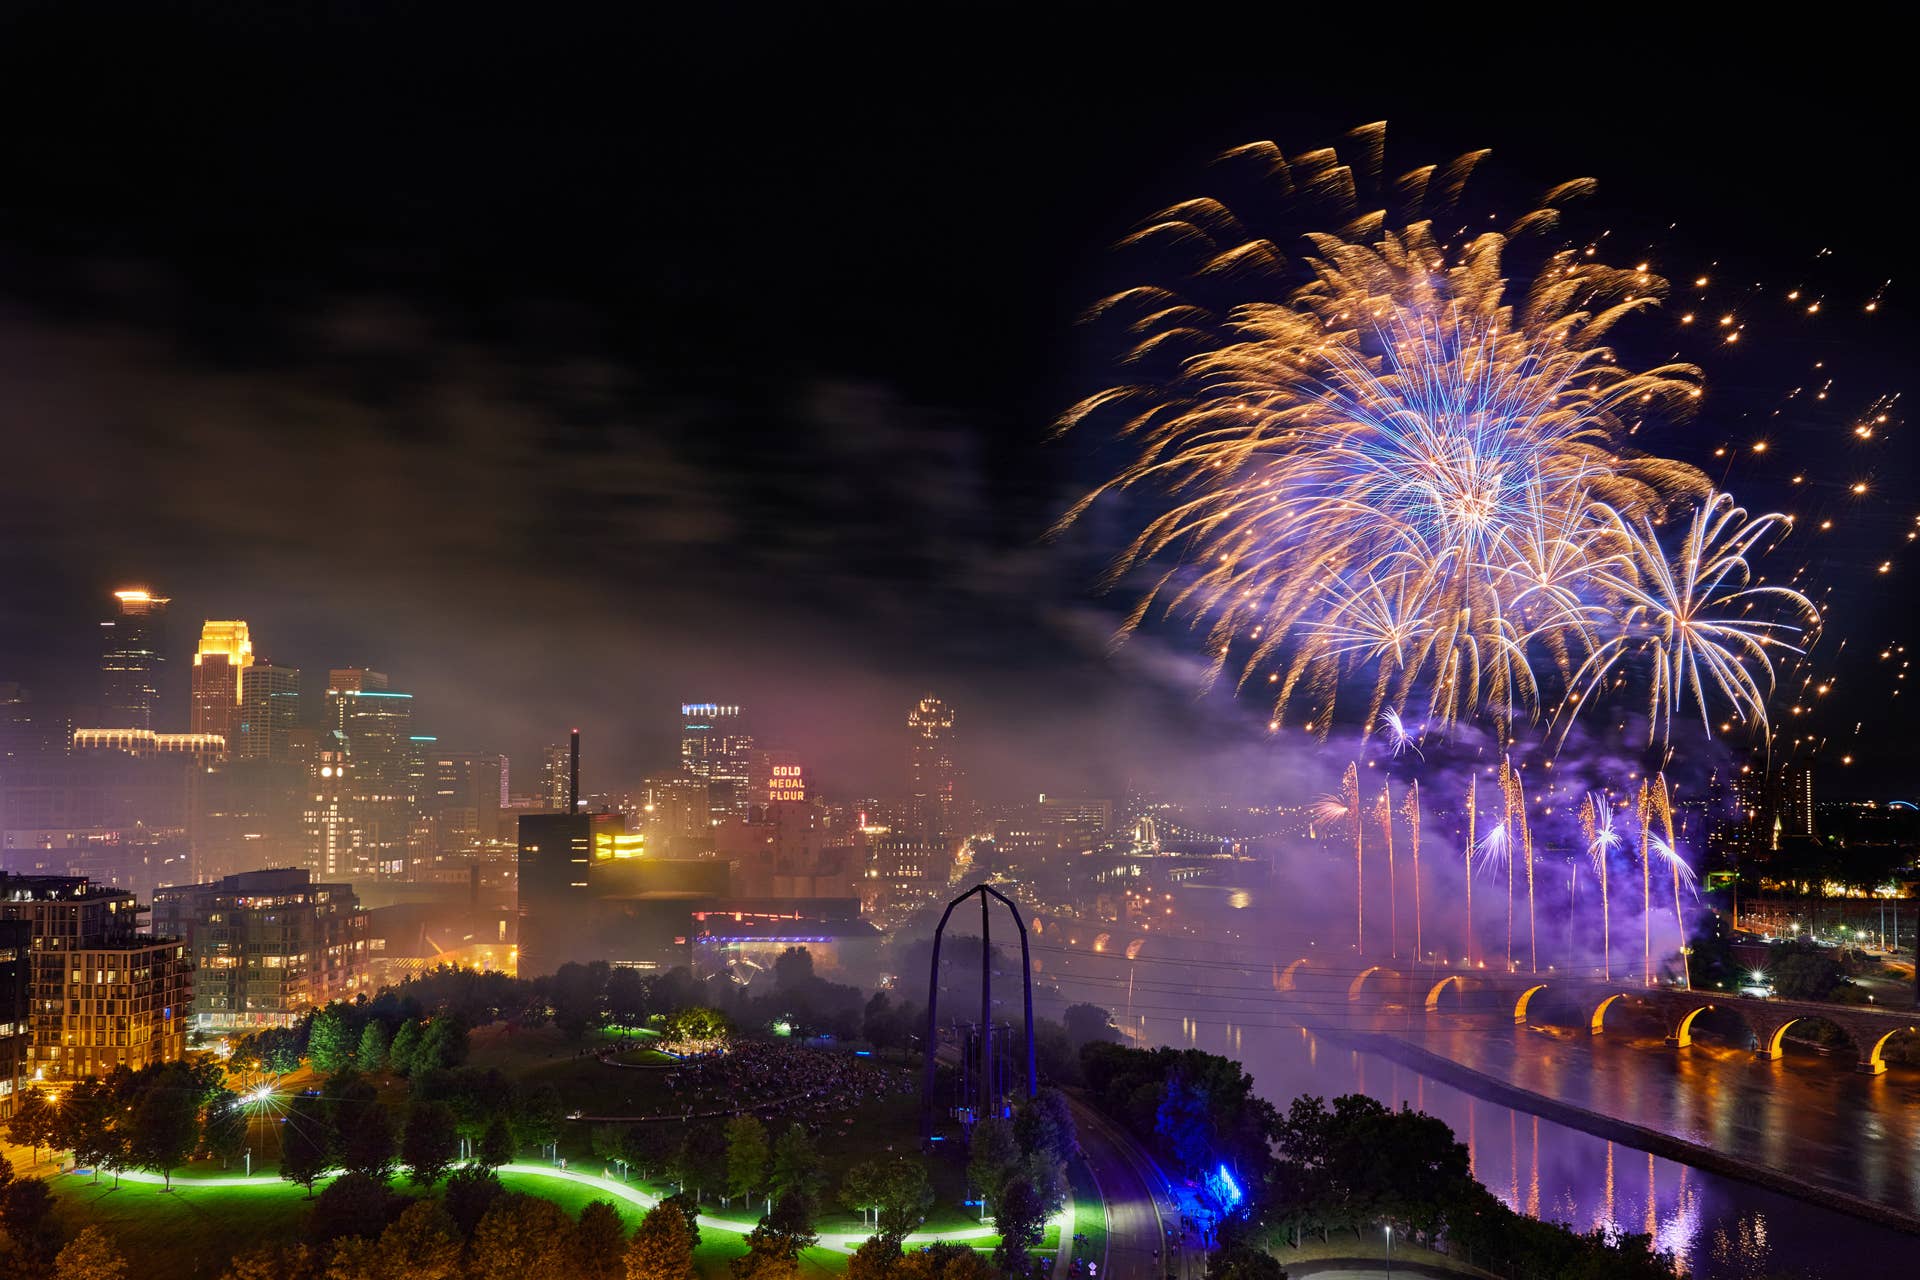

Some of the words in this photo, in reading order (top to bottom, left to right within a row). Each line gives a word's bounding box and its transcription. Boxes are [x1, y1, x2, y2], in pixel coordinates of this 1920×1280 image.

[773, 766, 801, 776] GOLD
[769, 779, 805, 788] MEDAL
[769, 791, 804, 801] FLOUR
